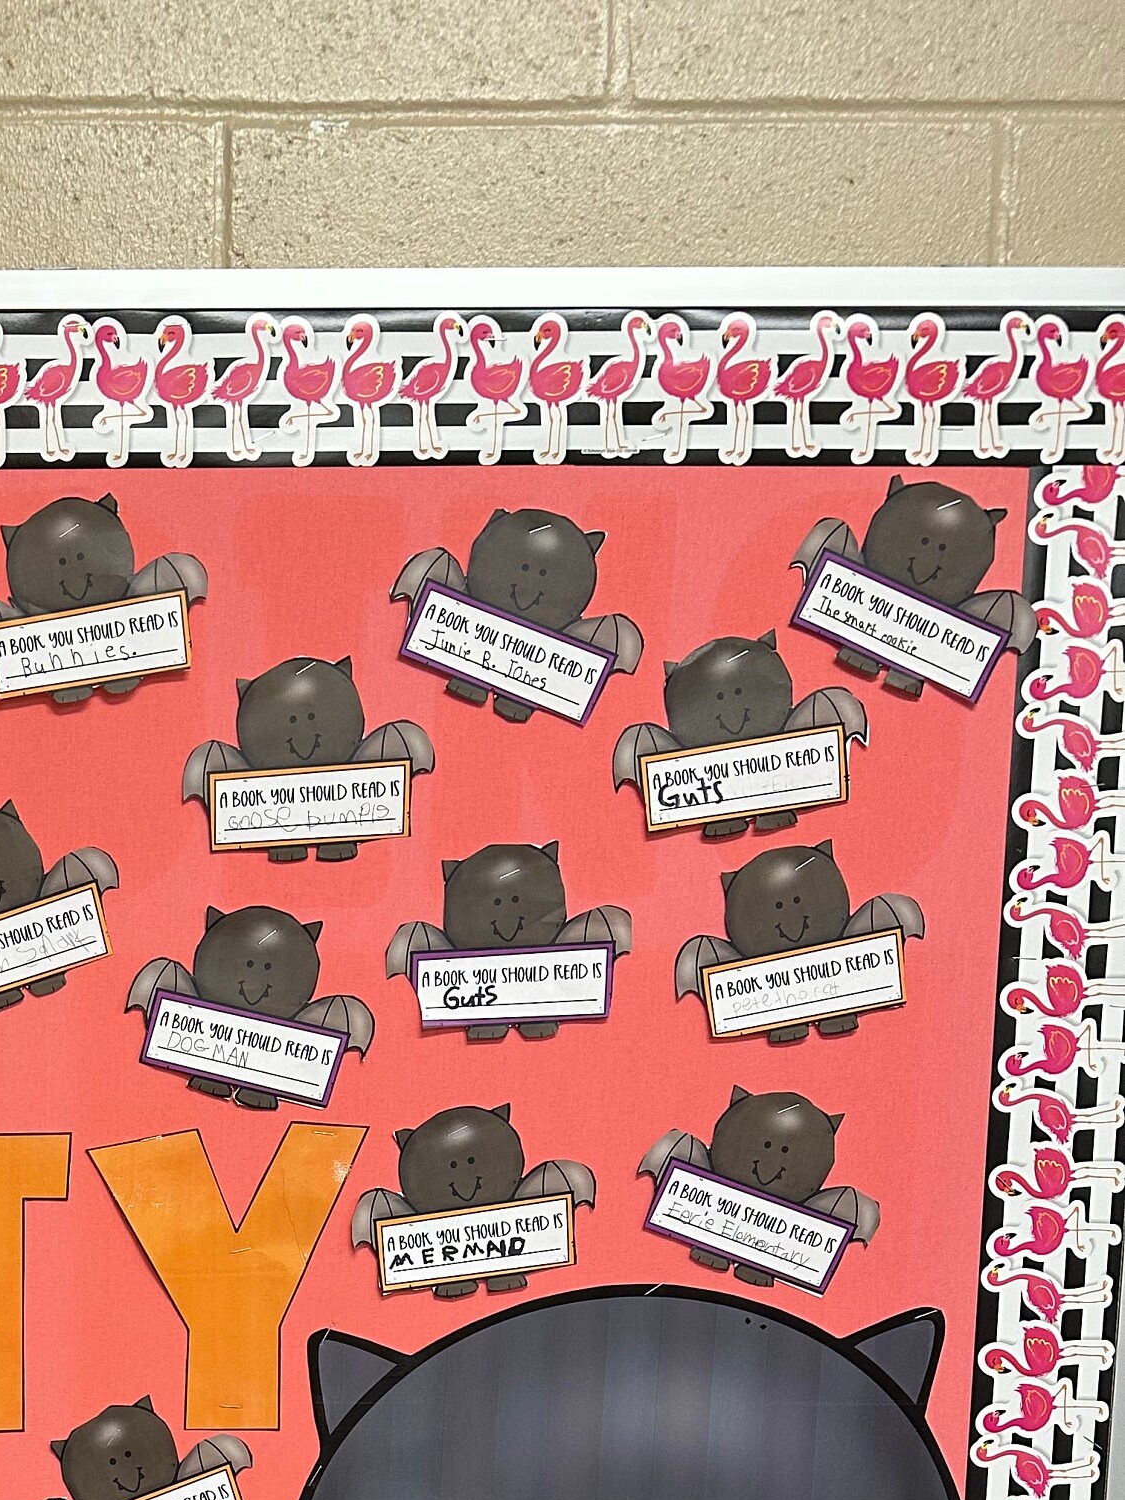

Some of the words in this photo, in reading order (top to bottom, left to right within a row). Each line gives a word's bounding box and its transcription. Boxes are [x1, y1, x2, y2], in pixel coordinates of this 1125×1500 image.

[10, 634, 45, 654] BOOK
[47, 629, 73, 648] YOU
[76, 620, 125, 643] SHOULD
[128, 613, 164, 634] READ
[167, 610, 178, 627] IS
[819, 573, 831, 589] A
[830, 577, 864, 604] BOOK
[868, 594, 893, 618] YOU
[893, 606, 939, 638] SHOULD
[940, 628, 974, 654] READ
[975, 645, 988, 661] IS
[423, 603, 435, 620] A
[435, 607, 469, 633] BOOK
[474, 622, 499, 645] YOU
[500, 633, 546, 663] SHOULD
[548, 652, 581, 677] READ
[583, 667, 595, 684] IS
[422, 971, 430, 987] A
[434, 969, 468, 986] BOOK
[472, 968, 496, 984] YOU
[501, 965, 549, 983] SHOULD
[553, 963, 588, 980] READ
[592, 962, 602, 978] IS
[159, 1011, 169, 1026] A
[171, 1013, 204, 1034] BOOK
[209, 1022, 233, 1041] YOU
[235, 1028, 281, 1052] SHOULD
[284, 1040, 318, 1061] READ
[320, 1049, 332, 1065] IS
[388, 1236, 396, 1251] A
[399, 1232, 432, 1250] BOOK
[435, 1227, 459, 1245] YOU
[463, 1220, 511, 1241] SHOULD
[515, 1215, 550, 1234] READ
[554, 1212, 565, 1228] IS
[218, 1483, 230, 1499] IS
